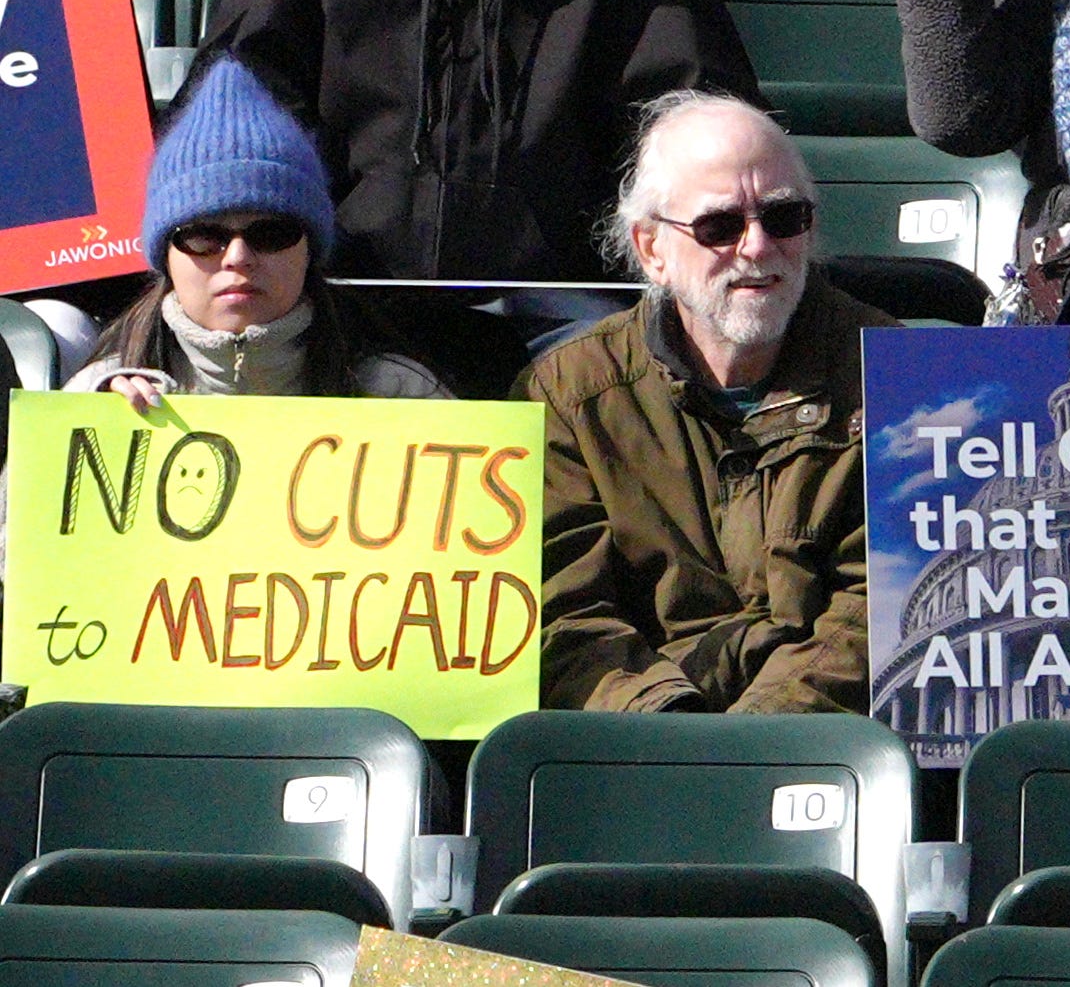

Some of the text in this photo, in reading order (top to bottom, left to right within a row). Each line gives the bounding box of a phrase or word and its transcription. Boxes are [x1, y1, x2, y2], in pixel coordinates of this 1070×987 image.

[913, 208, 948, 234] 10
[917, 422, 1036, 479] Tell
[60, 427, 530, 555] NO CUTS
[910, 495, 1056, 551] that
[37, 572, 537, 676] to MEDICAID
[914, 634, 1002, 688] All
[308, 785, 328, 813] 9
[787, 793, 825, 822] 10
